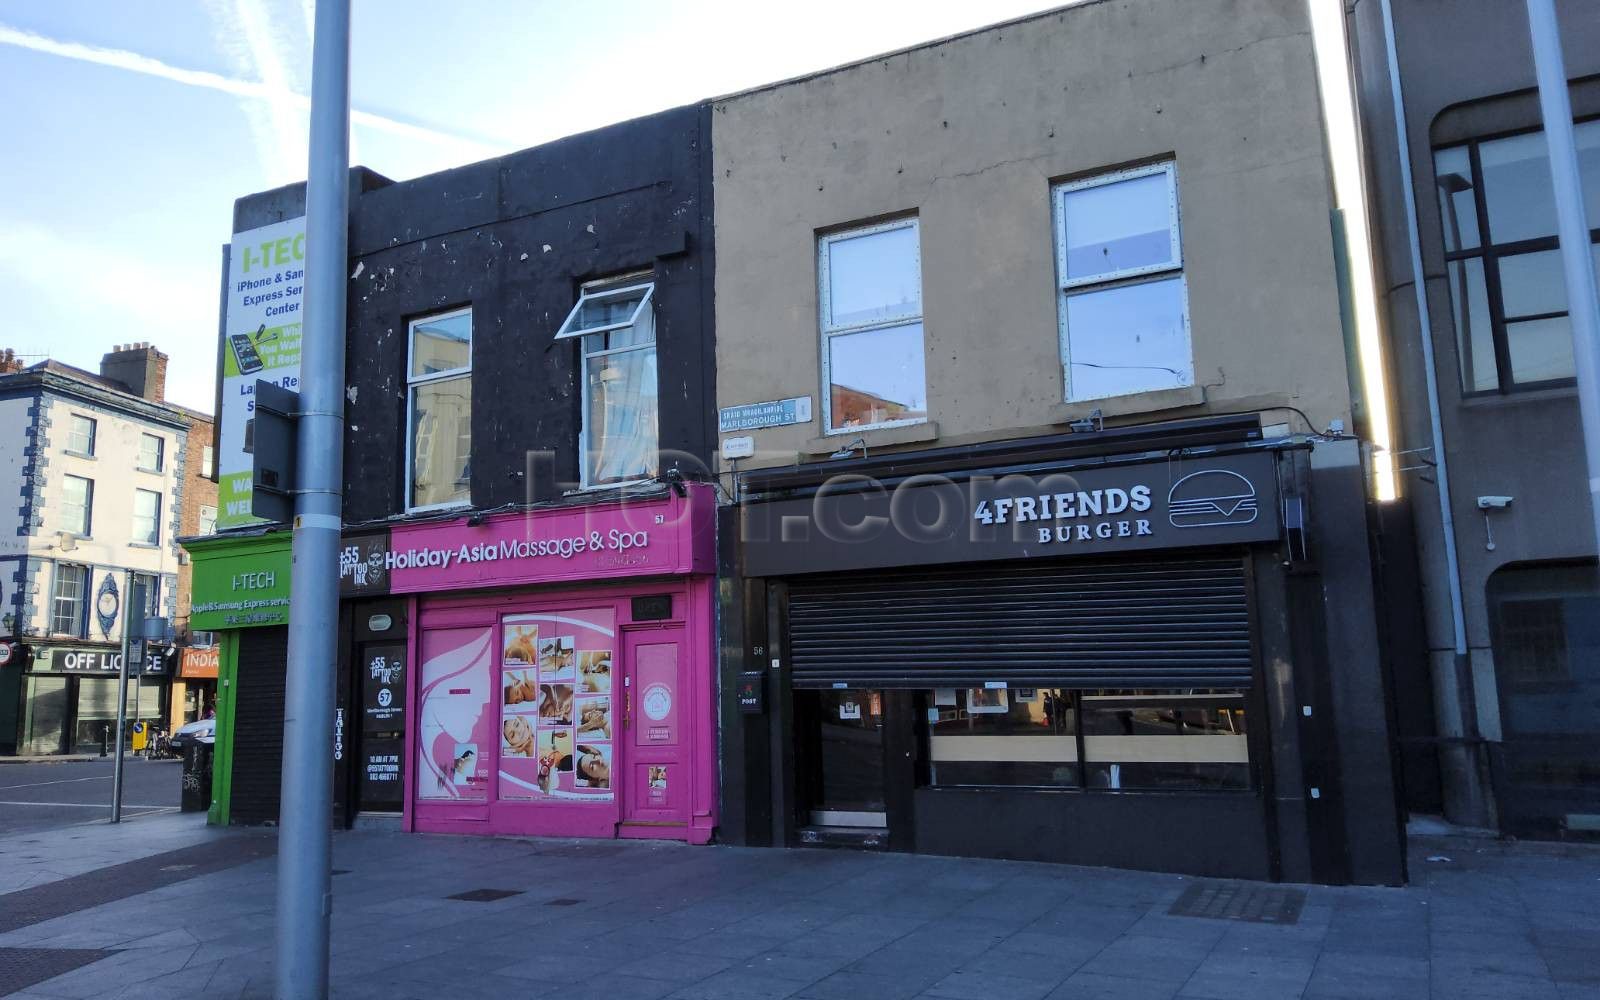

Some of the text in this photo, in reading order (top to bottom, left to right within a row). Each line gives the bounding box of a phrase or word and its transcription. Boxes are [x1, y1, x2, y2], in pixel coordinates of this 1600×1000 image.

[242, 233, 305, 273] I-TEC
[238, 277, 272, 293] iPhone
[275, 273, 283, 284] &
[243, 286, 303, 306] Express Ser
[265, 303, 300, 317] Center
[721, 413, 794, 429] MARLBOROUGH ST
[974, 485, 1152, 525] 4FRIENDS
[655, 514, 664, 524] 57
[1038, 519, 1153, 543] BURGER
[385, 542, 498, 570] Holiday-Asia
[500, 535, 586, 560] Massage
[589, 531, 605, 551] &
[608, 529, 648, 553] Spa
[340, 561, 368, 578] TATTOO
[233, 571, 275, 590] I-TECH
[354, 573, 368, 585] INK
[244, 598, 270, 611] Express
[753, 646, 763, 656] 56
[64, 653, 162, 670] OFF LICCE
[379, 693, 390, 703] 57
